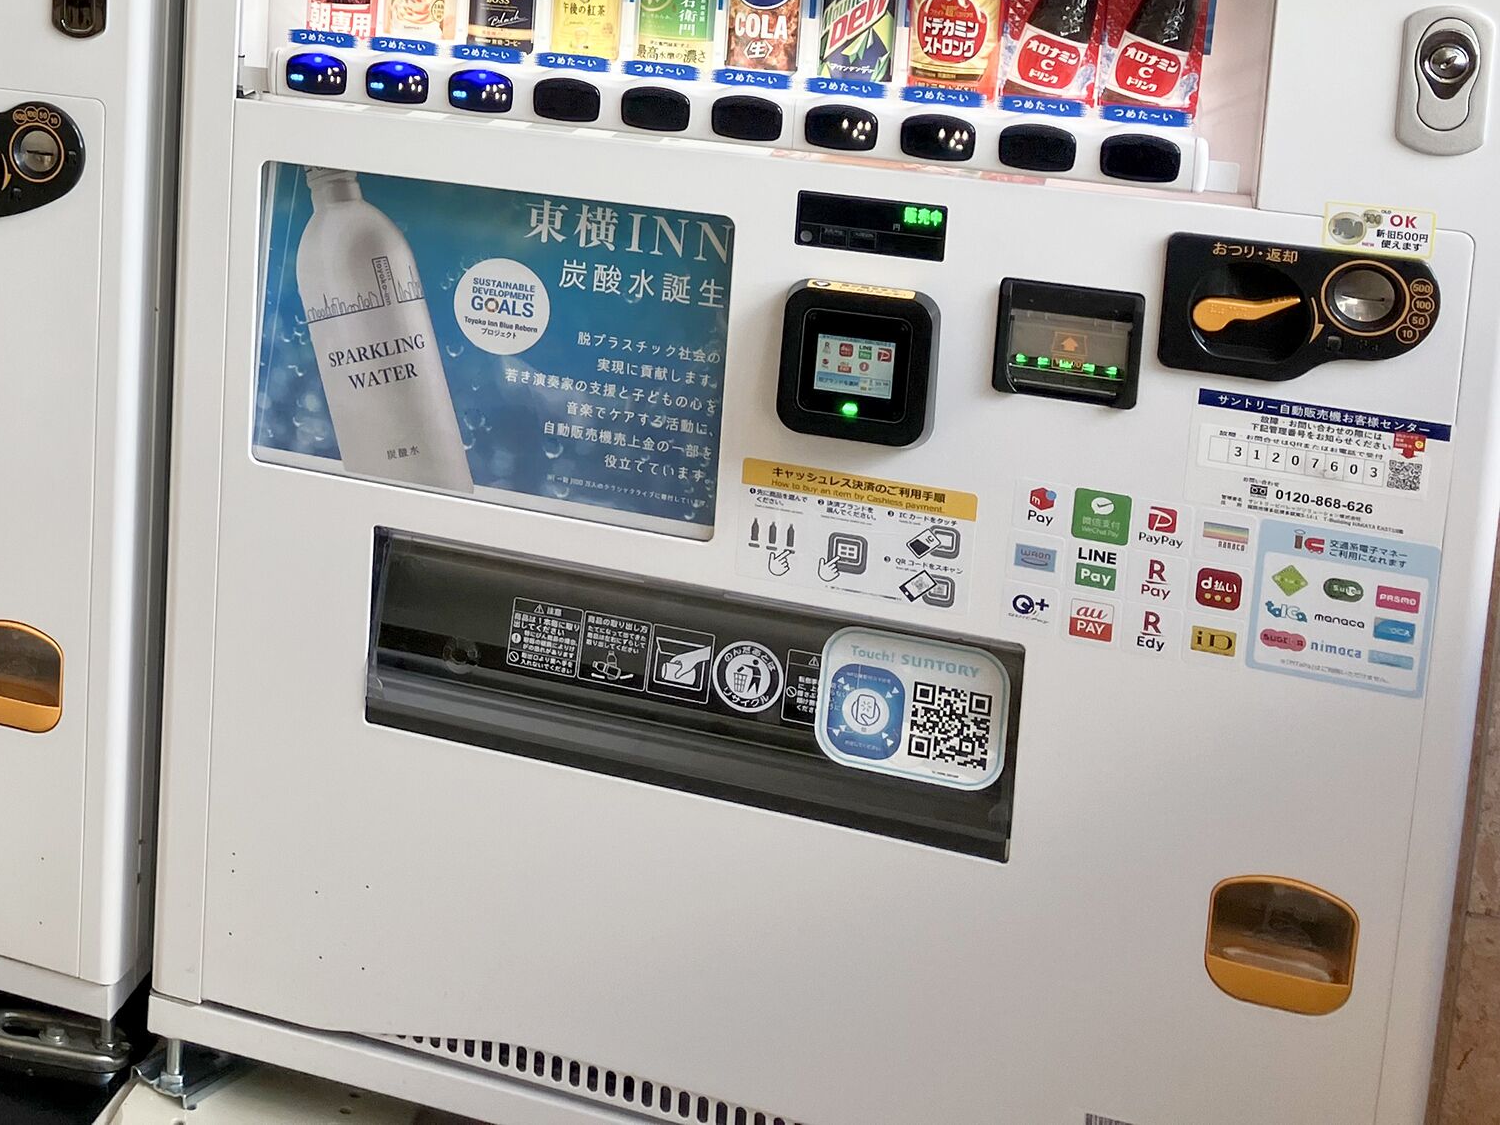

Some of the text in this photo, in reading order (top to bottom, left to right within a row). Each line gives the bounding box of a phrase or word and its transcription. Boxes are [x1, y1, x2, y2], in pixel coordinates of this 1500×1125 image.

[309, 1, 373, 34] 朝専用
[734, 13, 788, 40] COLA
[923, 17, 979, 38] ドデカミン
[924, 37, 976, 57] ストロング
[1026, 38, 1078, 65] オロナミン
[904, 206, 943, 226] 販売中
[1390, 214, 1417, 229] OK
[524, 200, 732, 265] 東横INN
[1212, 241, 1298, 264] おつり・返却
[1381, 240, 1422, 251] 使えます
[472, 286, 535, 302] DEVELOPMENT
[473, 277, 536, 294] SUSTAINABLE
[559, 259, 725, 309] 炭酸水誕生
[1412, 283, 1432, 294] 500
[471, 296, 534, 318] GOALS
[1415, 300, 1432, 311] 100
[1412, 314, 1425, 325] 50
[481, 327, 517, 340] プロジェクト
[1401, 329, 1413, 339] 10
[329, 333, 425, 368] SPARKLING
[577, 331, 720, 364] 脱プラスチック社会の
[348, 362, 418, 390] WATER
[597, 358, 718, 389] 実現に貢献します。
[505, 368, 717, 415] 若き演奏家の支援と子どもの心を
[566, 400, 715, 437] 音楽でケアする活動に、
[1218, 394, 1430, 434] サントリー自動販売機お客様センター
[544, 420, 712, 460] 自動販売機売上金の一部を
[1252, 423, 1391, 450] 下記管理番号をお知らせください
[386, 445, 420, 460] 炭酸水
[604, 453, 713, 484] 役立てています。
[771, 480, 789, 489] How
[803, 484, 816, 494] buy
[832, 490, 852, 499] item
[854, 493, 865, 502] by
[867, 494, 903, 508] Cashless
[772, 466, 946, 504] キャッシュレス決済のご利用手順
[1275, 489, 1373, 515] 0120-868-626
[1028, 509, 1053, 526] Pay
[1138, 532, 1183, 549] PayPay
[1330, 539, 1408, 558] 交通系電子マネー
[1078, 547, 1117, 565] LINE
[1329, 549, 1406, 568] ご利用になれます
[1080, 568, 1112, 586] Pay
[1200, 577, 1237, 593] d払い
[1141, 584, 1171, 601] Pay
[1379, 593, 1416, 606] PASMO
[1076, 606, 1109, 619] au
[1314, 613, 1365, 628] manaca
[1076, 619, 1106, 634] PAY
[1136, 636, 1165, 652] Edy
[1311, 640, 1362, 659] nimoca
[851, 645, 895, 663] Touch!
[902, 654, 980, 678] SUNTORY
[722, 687, 769, 709] リサイクル
